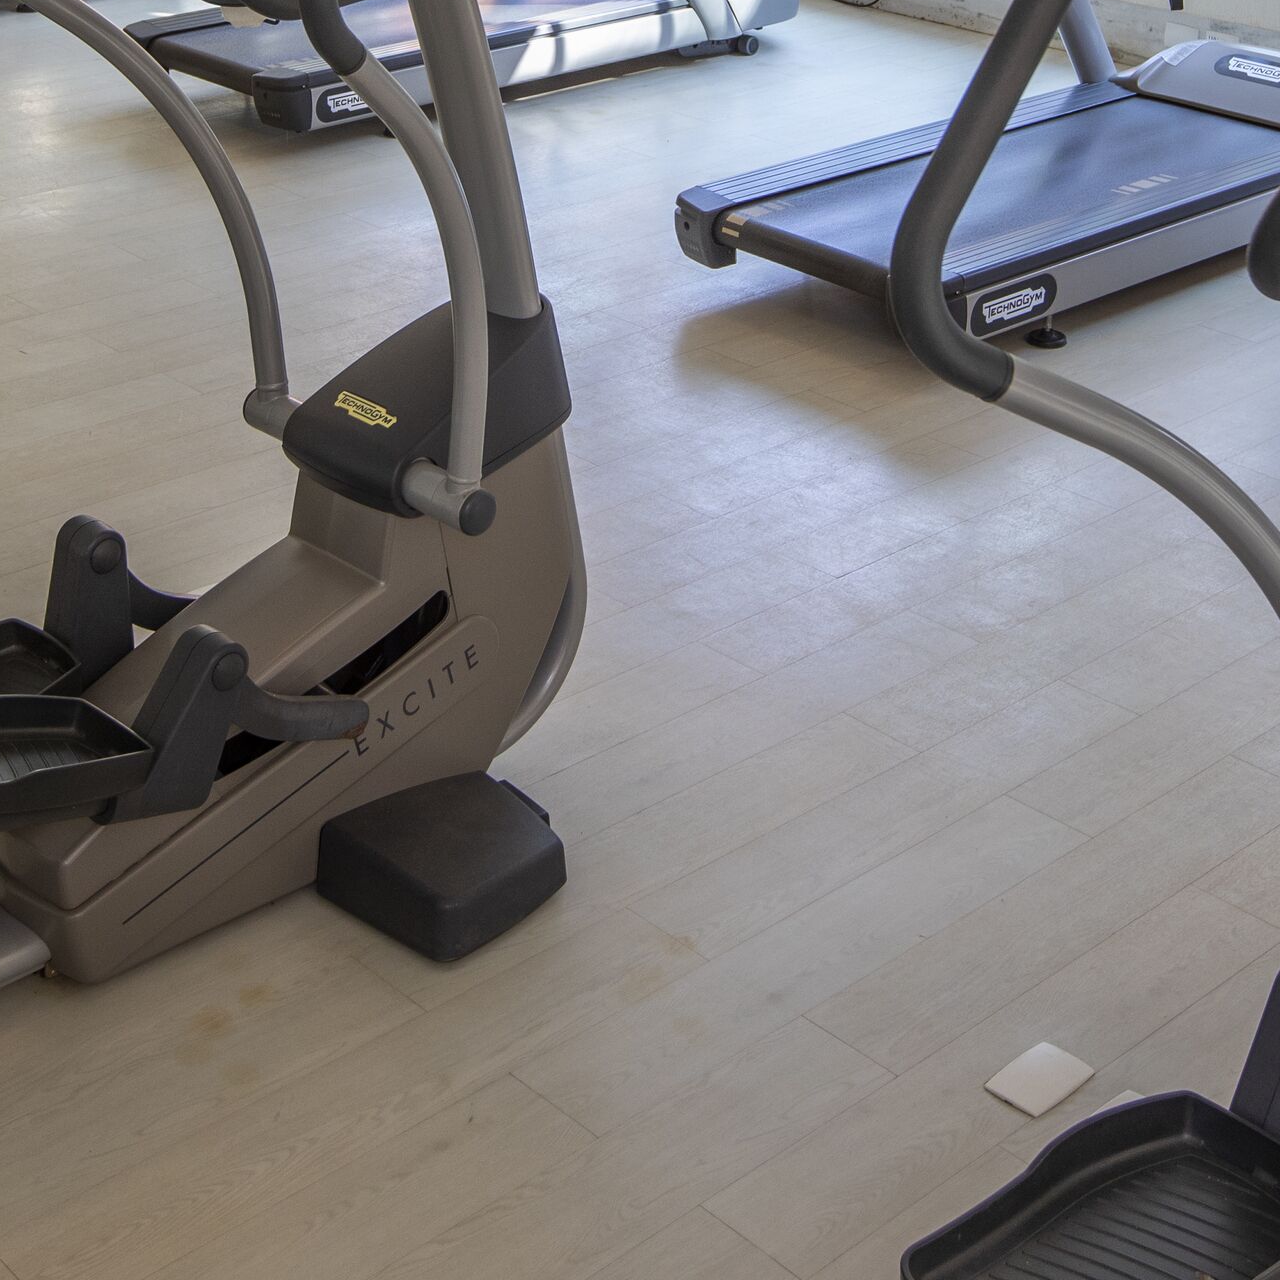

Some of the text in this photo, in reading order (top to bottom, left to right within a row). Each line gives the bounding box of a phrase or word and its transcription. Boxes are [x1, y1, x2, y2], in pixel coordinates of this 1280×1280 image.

[328, 95, 361, 109] TECHN
[984, 286, 1045, 322] TECHNOGYM
[339, 394, 393, 426] TECHNOGYM
[354, 644, 480, 758] EXCITE
